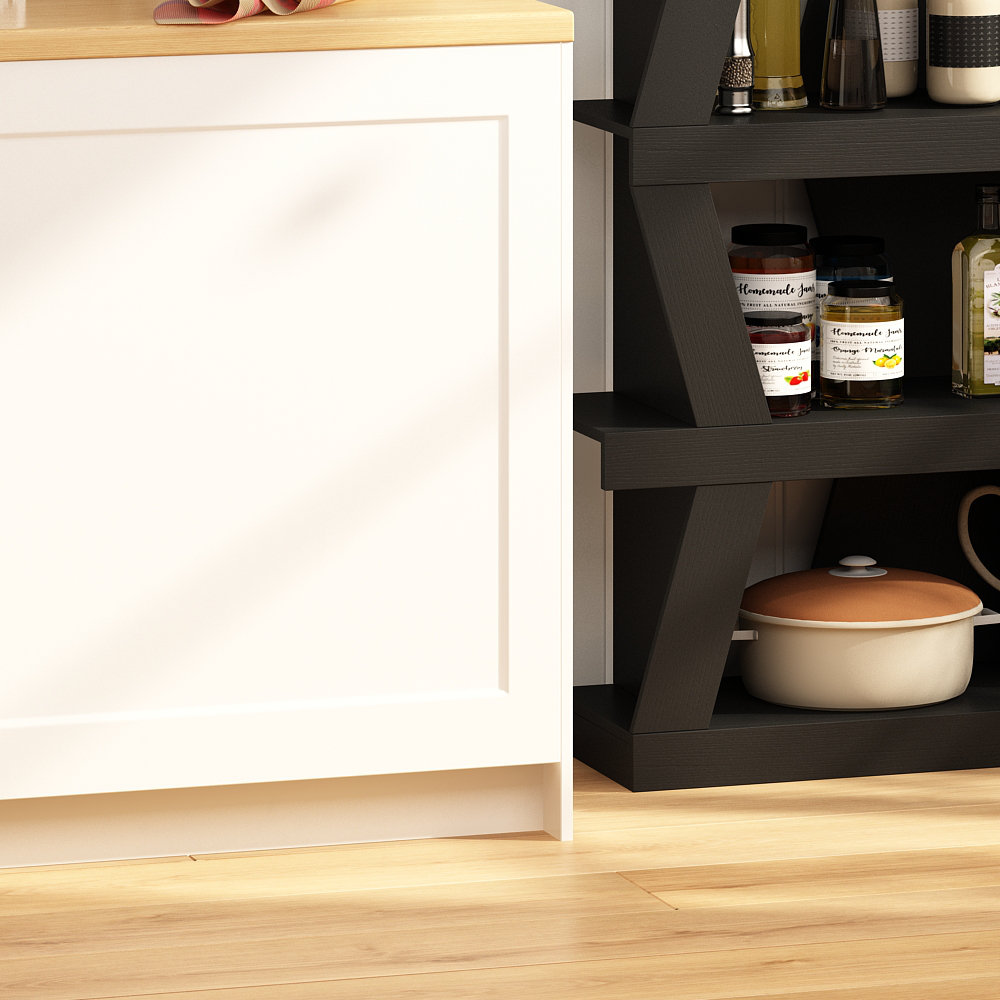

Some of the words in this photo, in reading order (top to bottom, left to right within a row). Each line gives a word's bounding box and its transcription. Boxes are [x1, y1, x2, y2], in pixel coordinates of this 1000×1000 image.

[736, 283, 796, 296] Homemade
[830, 328, 882, 337] Homemade
[752, 348, 794, 356] omemade
